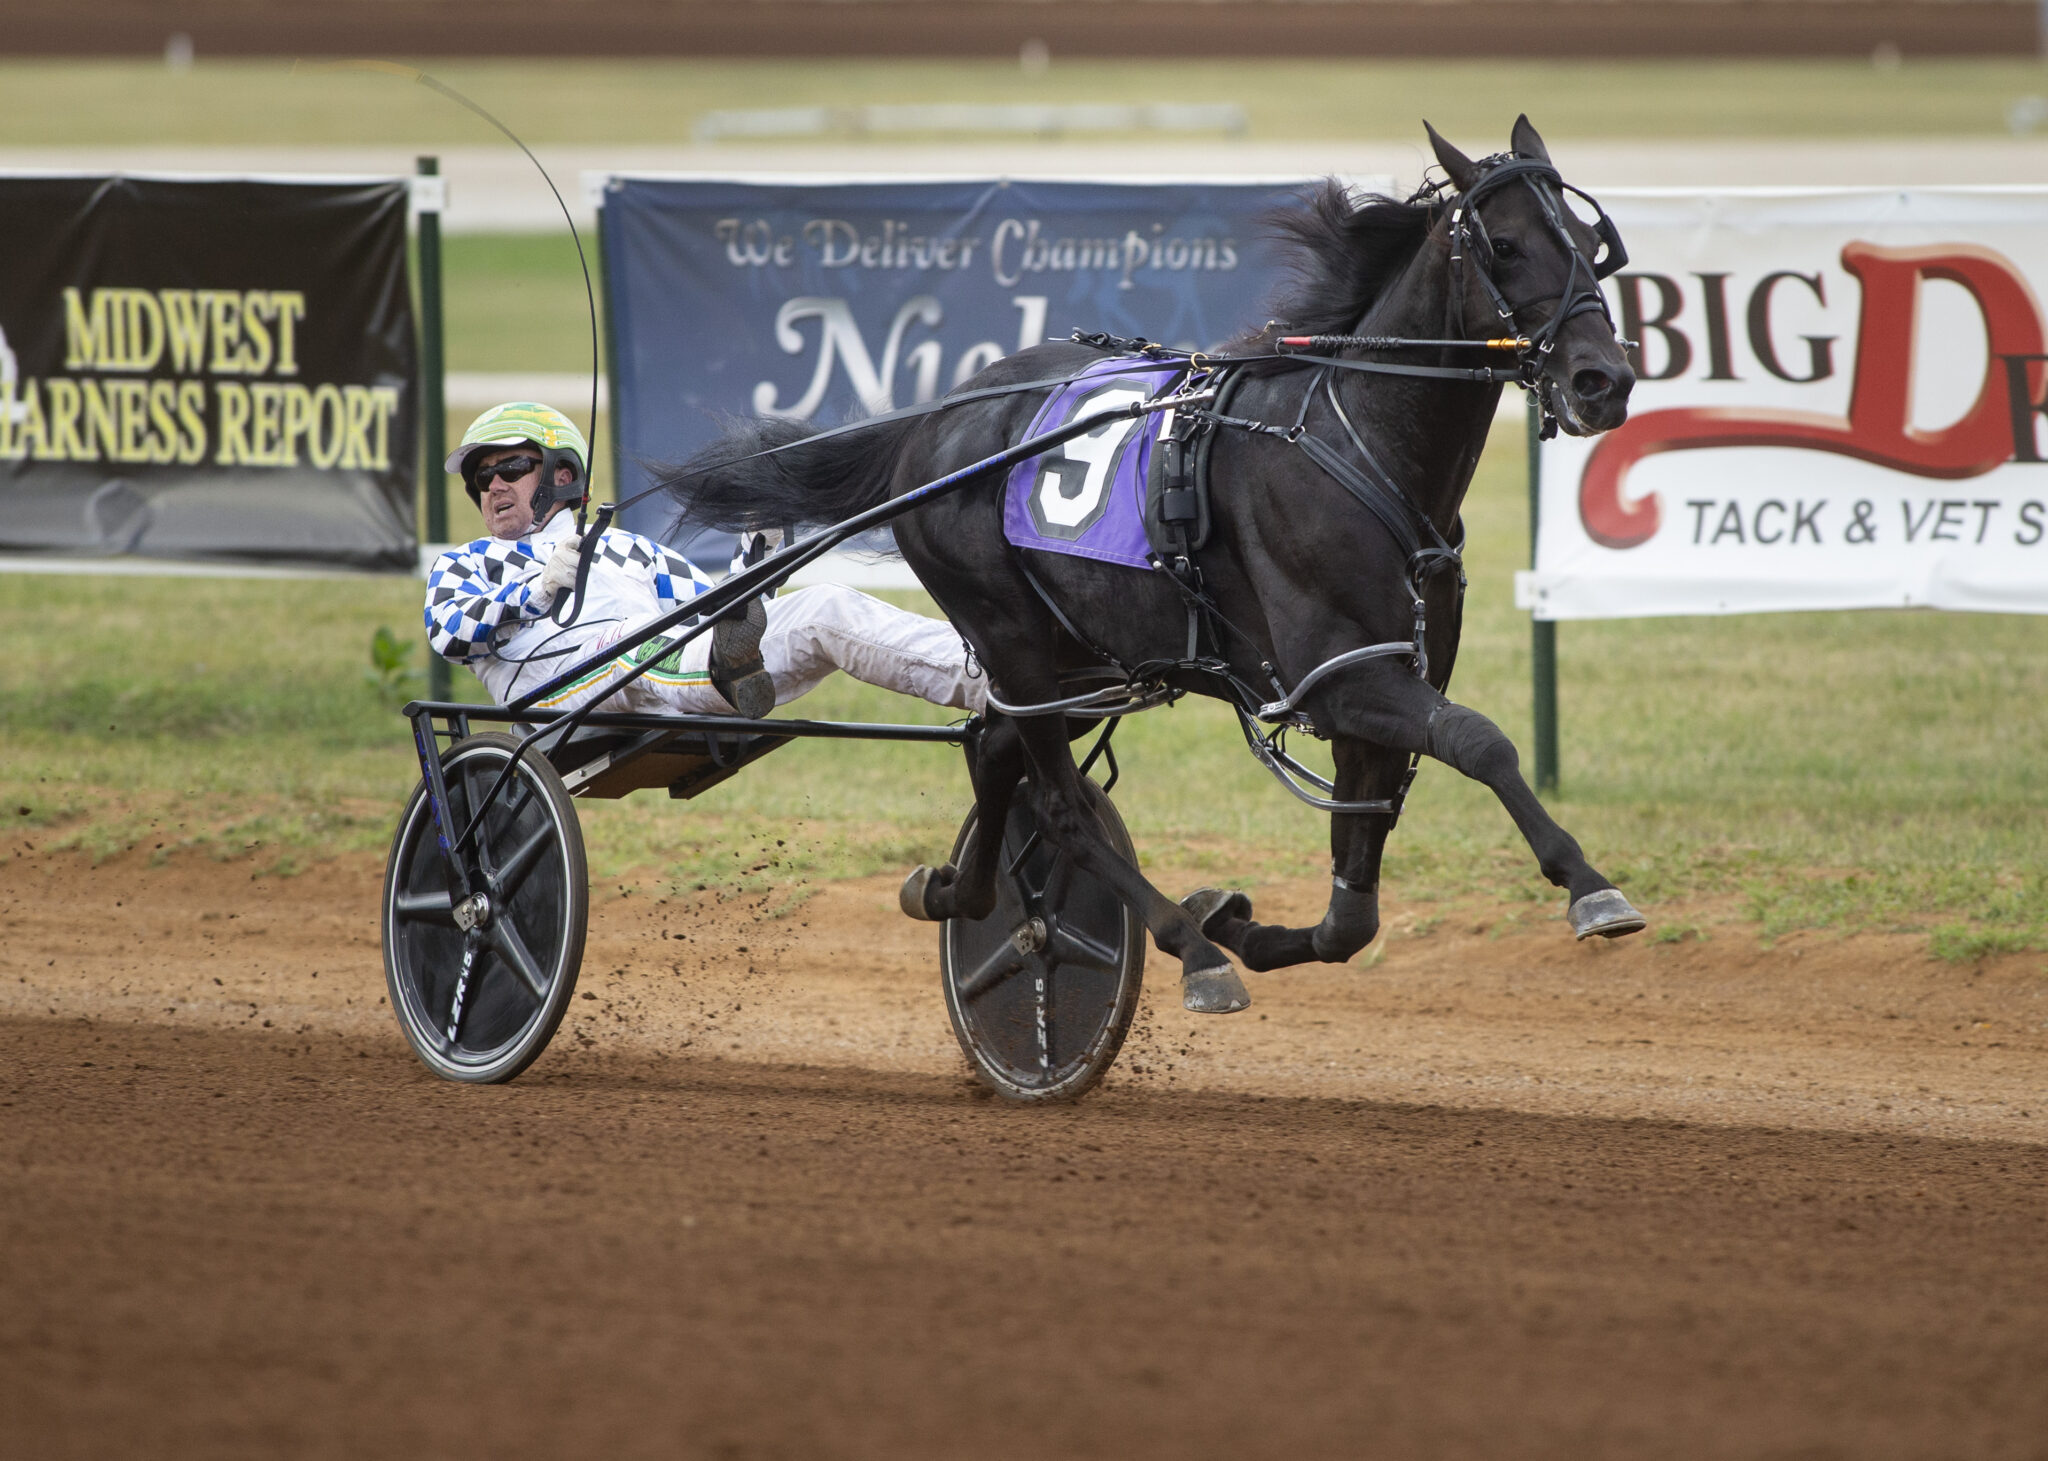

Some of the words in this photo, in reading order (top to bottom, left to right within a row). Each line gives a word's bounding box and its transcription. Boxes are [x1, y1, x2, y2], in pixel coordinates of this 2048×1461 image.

[714, 219, 794, 267] We
[804, 219, 981, 270] Deliver
[992, 218, 1238, 287] Champions
[64, 287, 304, 373] MIDWEST
[1612, 271, 1839, 384] BIG
[216, 383, 397, 470] REPORT
[1038, 388, 1147, 527] 9
[1686, 500, 1829, 545] TACK
[1844, 500, 1877, 545] &
[1899, 500, 2001, 545] VET
[2014, 500, 2046, 546] S
